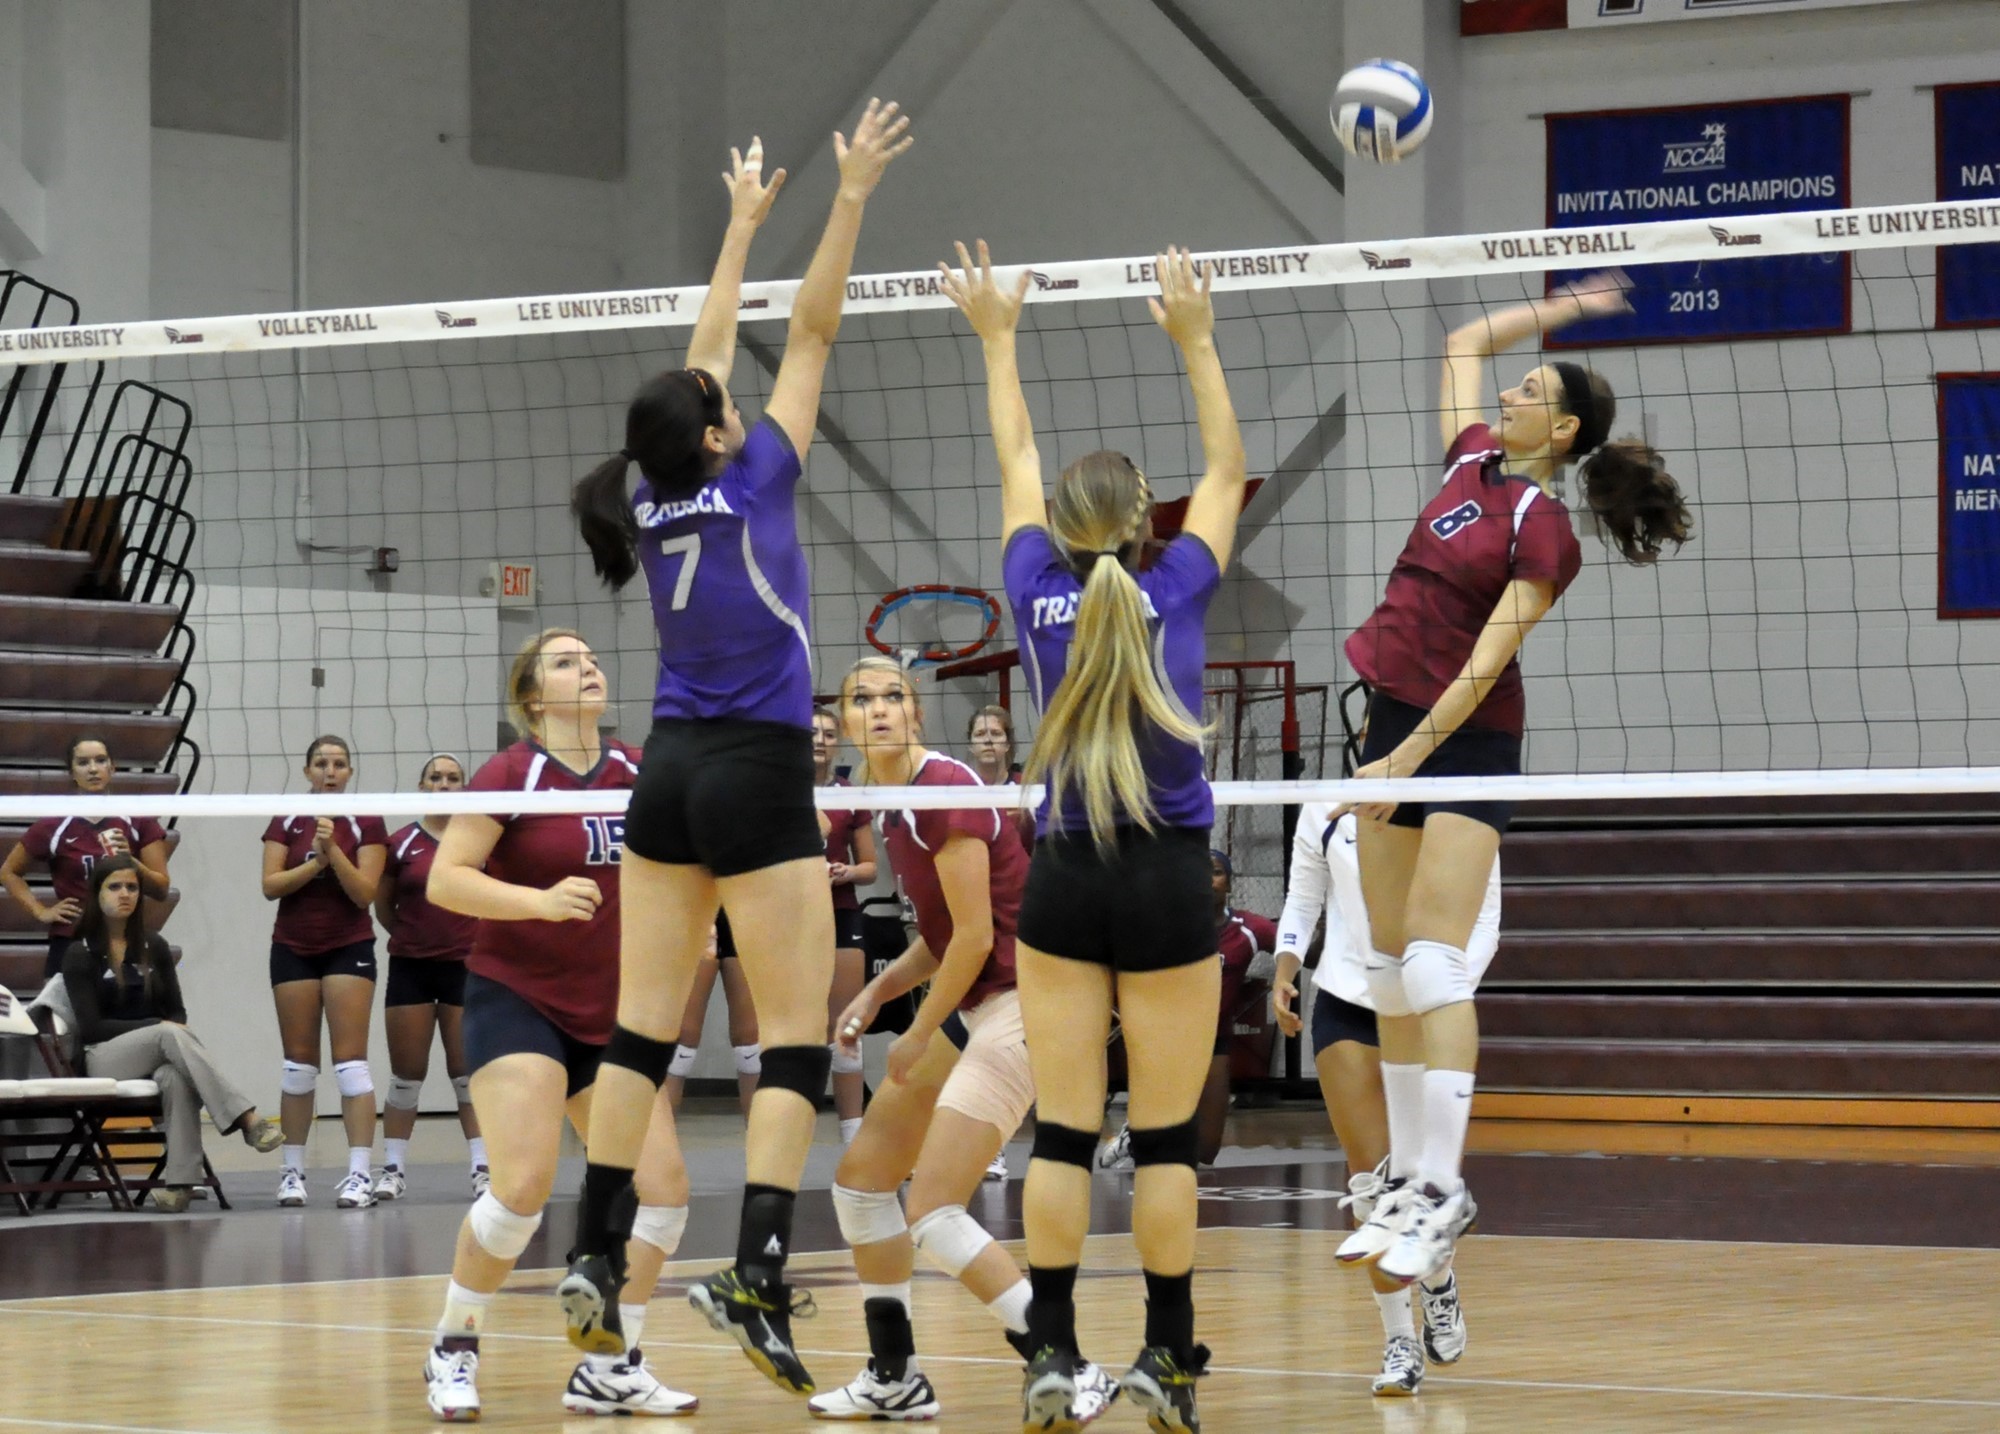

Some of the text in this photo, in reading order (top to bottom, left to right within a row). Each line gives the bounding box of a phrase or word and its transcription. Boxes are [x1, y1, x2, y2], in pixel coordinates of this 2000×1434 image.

[1961, 164, 2000, 187] NA
[1558, 175, 1836, 214] INVITATIONAL CHAMPIONS
[1816, 216, 1860, 238] LEE
[1481, 231, 1636, 259] VOLLEYBALL
[847, 276, 947, 300] OLLEYBA
[517, 294, 679, 321] LEE UNIVERSITY
[1669, 289, 1721, 313] 2013
[258, 313, 378, 336] VOLLEYBALL
[18, 328, 125, 350] UNIVERSITY
[1964, 454, 2000, 477] NA
[1429, 500, 1482, 541] 8
[503, 566, 532, 596] EXIT
[661, 532, 702, 611] 7
